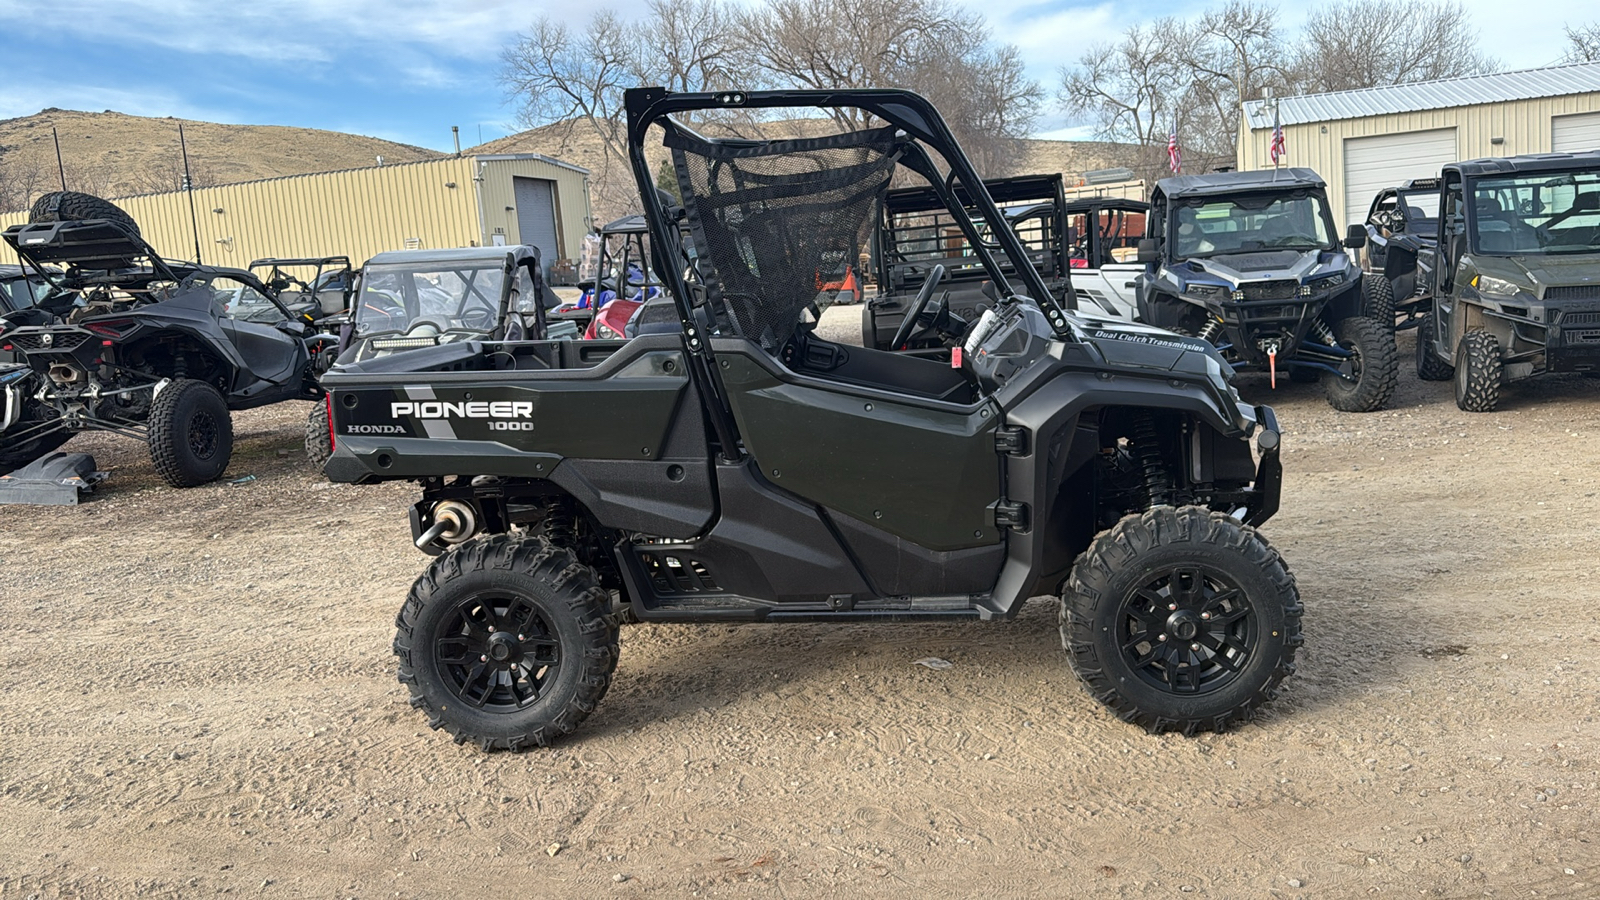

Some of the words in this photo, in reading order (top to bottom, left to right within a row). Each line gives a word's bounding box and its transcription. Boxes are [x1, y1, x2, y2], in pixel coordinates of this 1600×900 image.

[1095, 330, 1117, 340] Dual
[1118, 333, 1148, 343] Clutch
[1149, 337, 1205, 352] Transmission
[391, 401, 534, 419] PIONEER
[347, 424, 407, 434] HONDA
[487, 421, 535, 431] 1000
